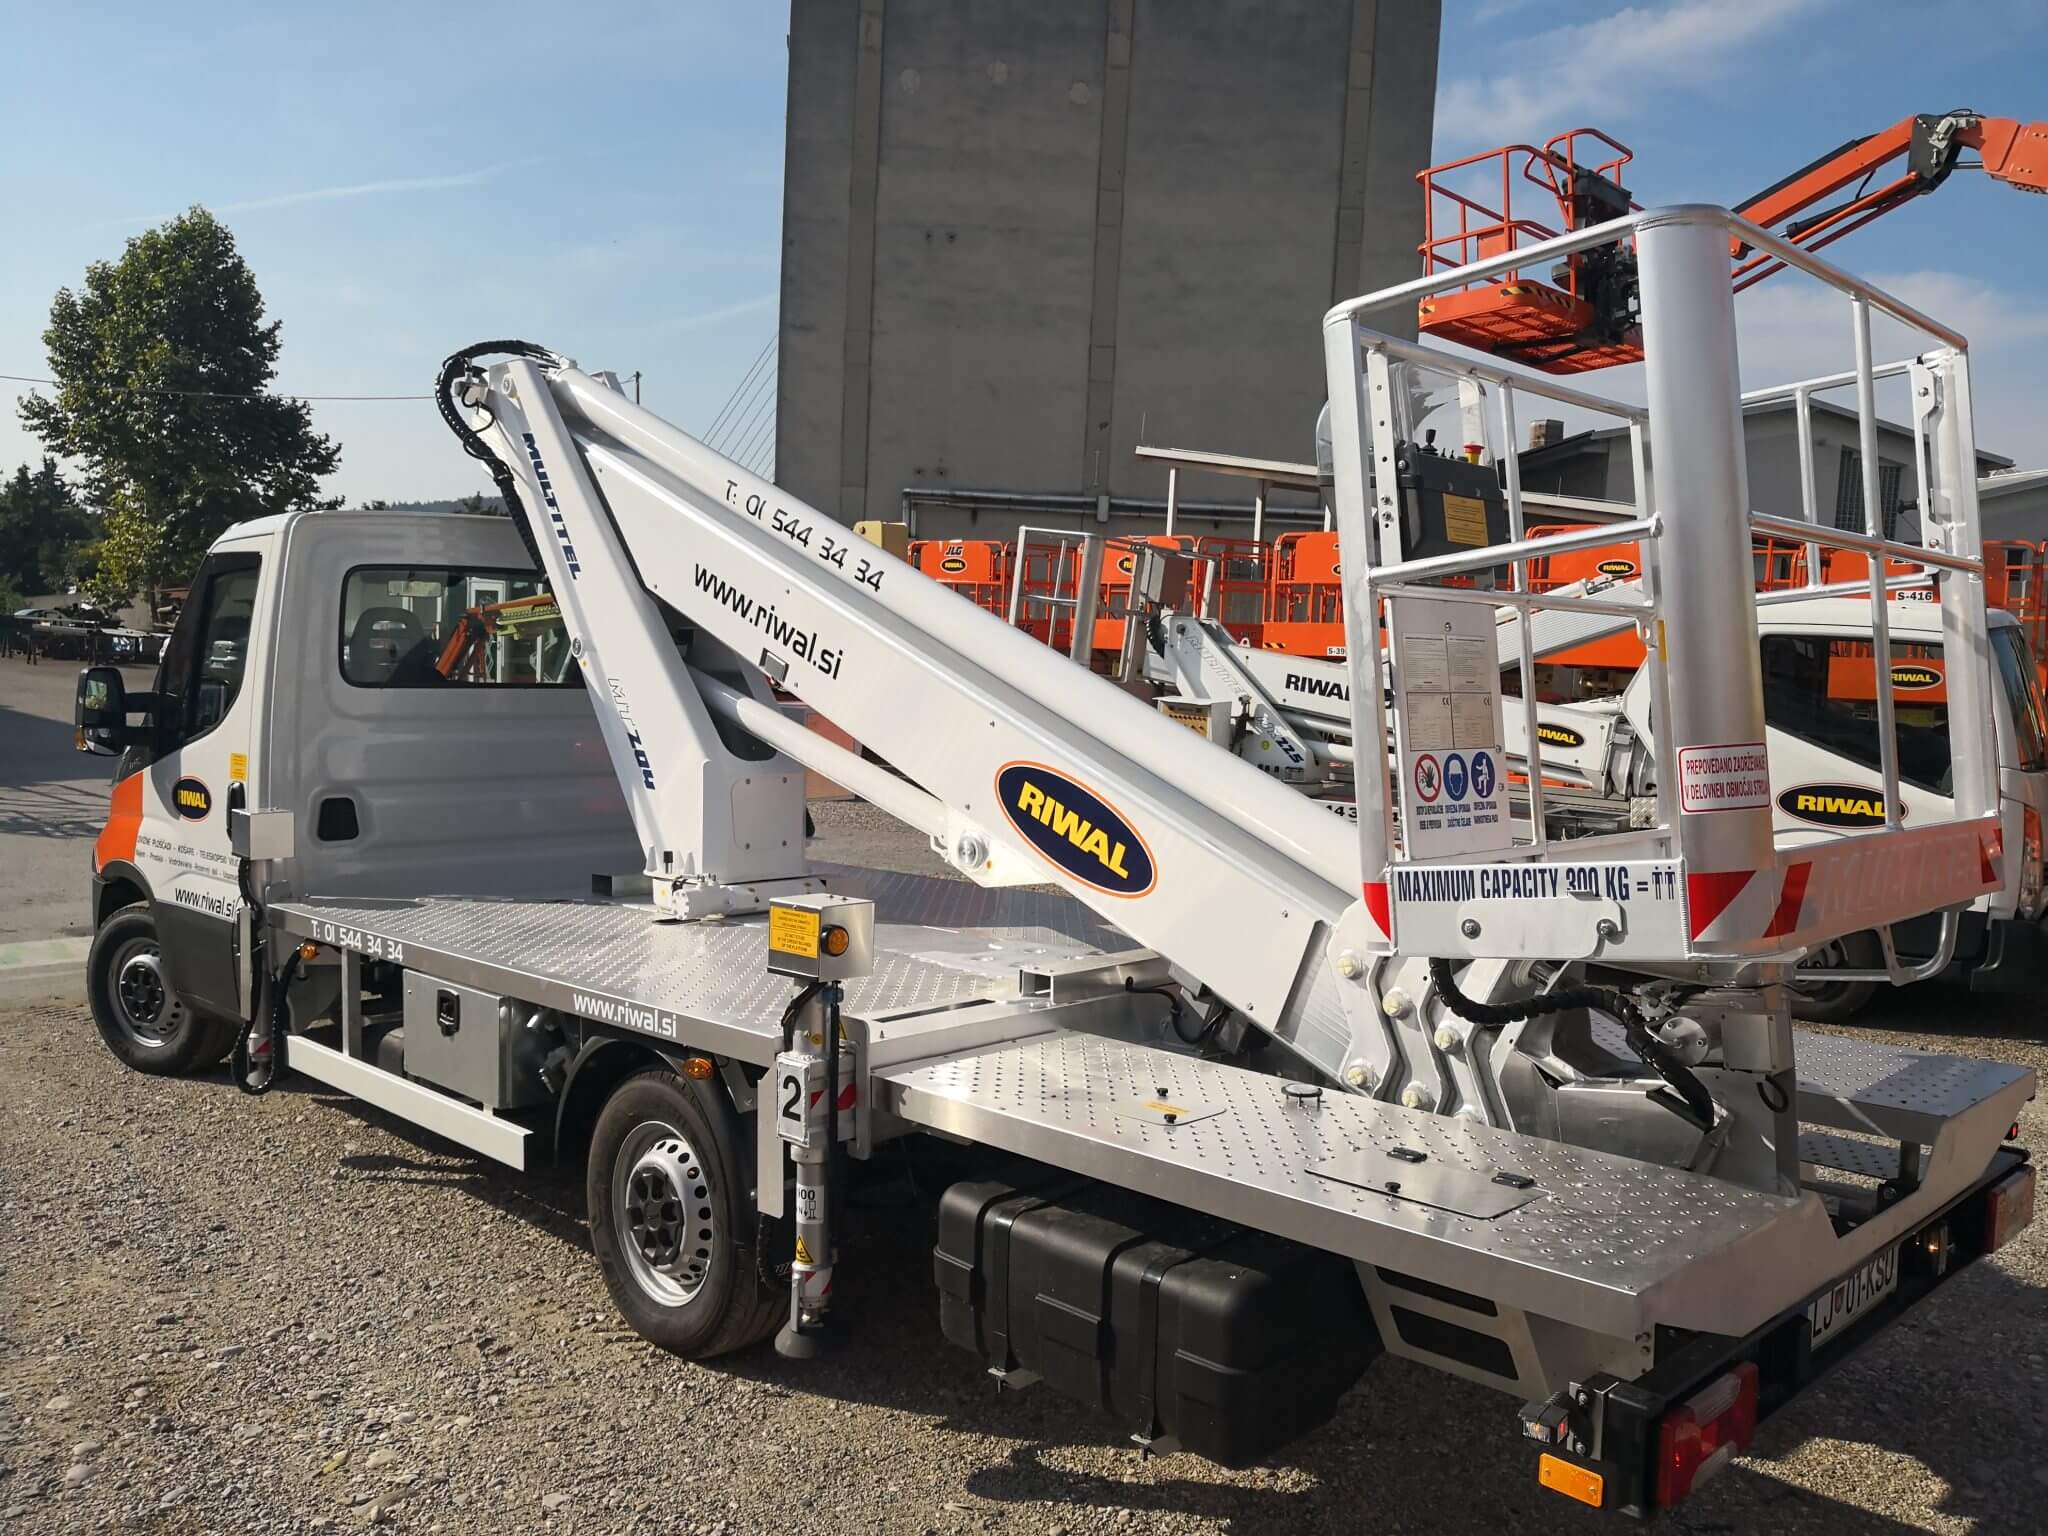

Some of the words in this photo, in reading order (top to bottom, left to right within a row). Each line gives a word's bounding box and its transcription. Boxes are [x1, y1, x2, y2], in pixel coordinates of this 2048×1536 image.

[522, 433, 581, 580] MULTITEL
[726, 480, 738, 504] T:
[771, 508, 813, 548] 544
[819, 537, 848, 570] 34
[854, 558, 884, 593] 34
[1897, 591, 1933, 601] S-416
[695, 563, 843, 680] www.riwal.si
[1686, 757, 1733, 775] PREPOVEDANO
[178, 789, 207, 809] RIWAL
[1691, 781, 1725, 800] DELOVNEM
[1797, 794, 1886, 817] RIWAL
[1017, 780, 1129, 880] RIWAL
[175, 887, 236, 918] www.riwal.si
[1397, 868, 1475, 902] MAXIMUM
[1480, 867, 1558, 899] CAPACITY
[1566, 866, 1600, 898] 300
[1605, 866, 1630, 900] KG
[311, 919, 320, 938] T:
[324, 924, 335, 942] 01
[340, 928, 362, 950] 544
[367, 934, 382, 957] 34
[387, 940, 403, 962] 34
[573, 993, 677, 1038] www.riwal.si
[782, 1074, 801, 1122] 2
[1813, 1289, 1834, 1336] LJ
